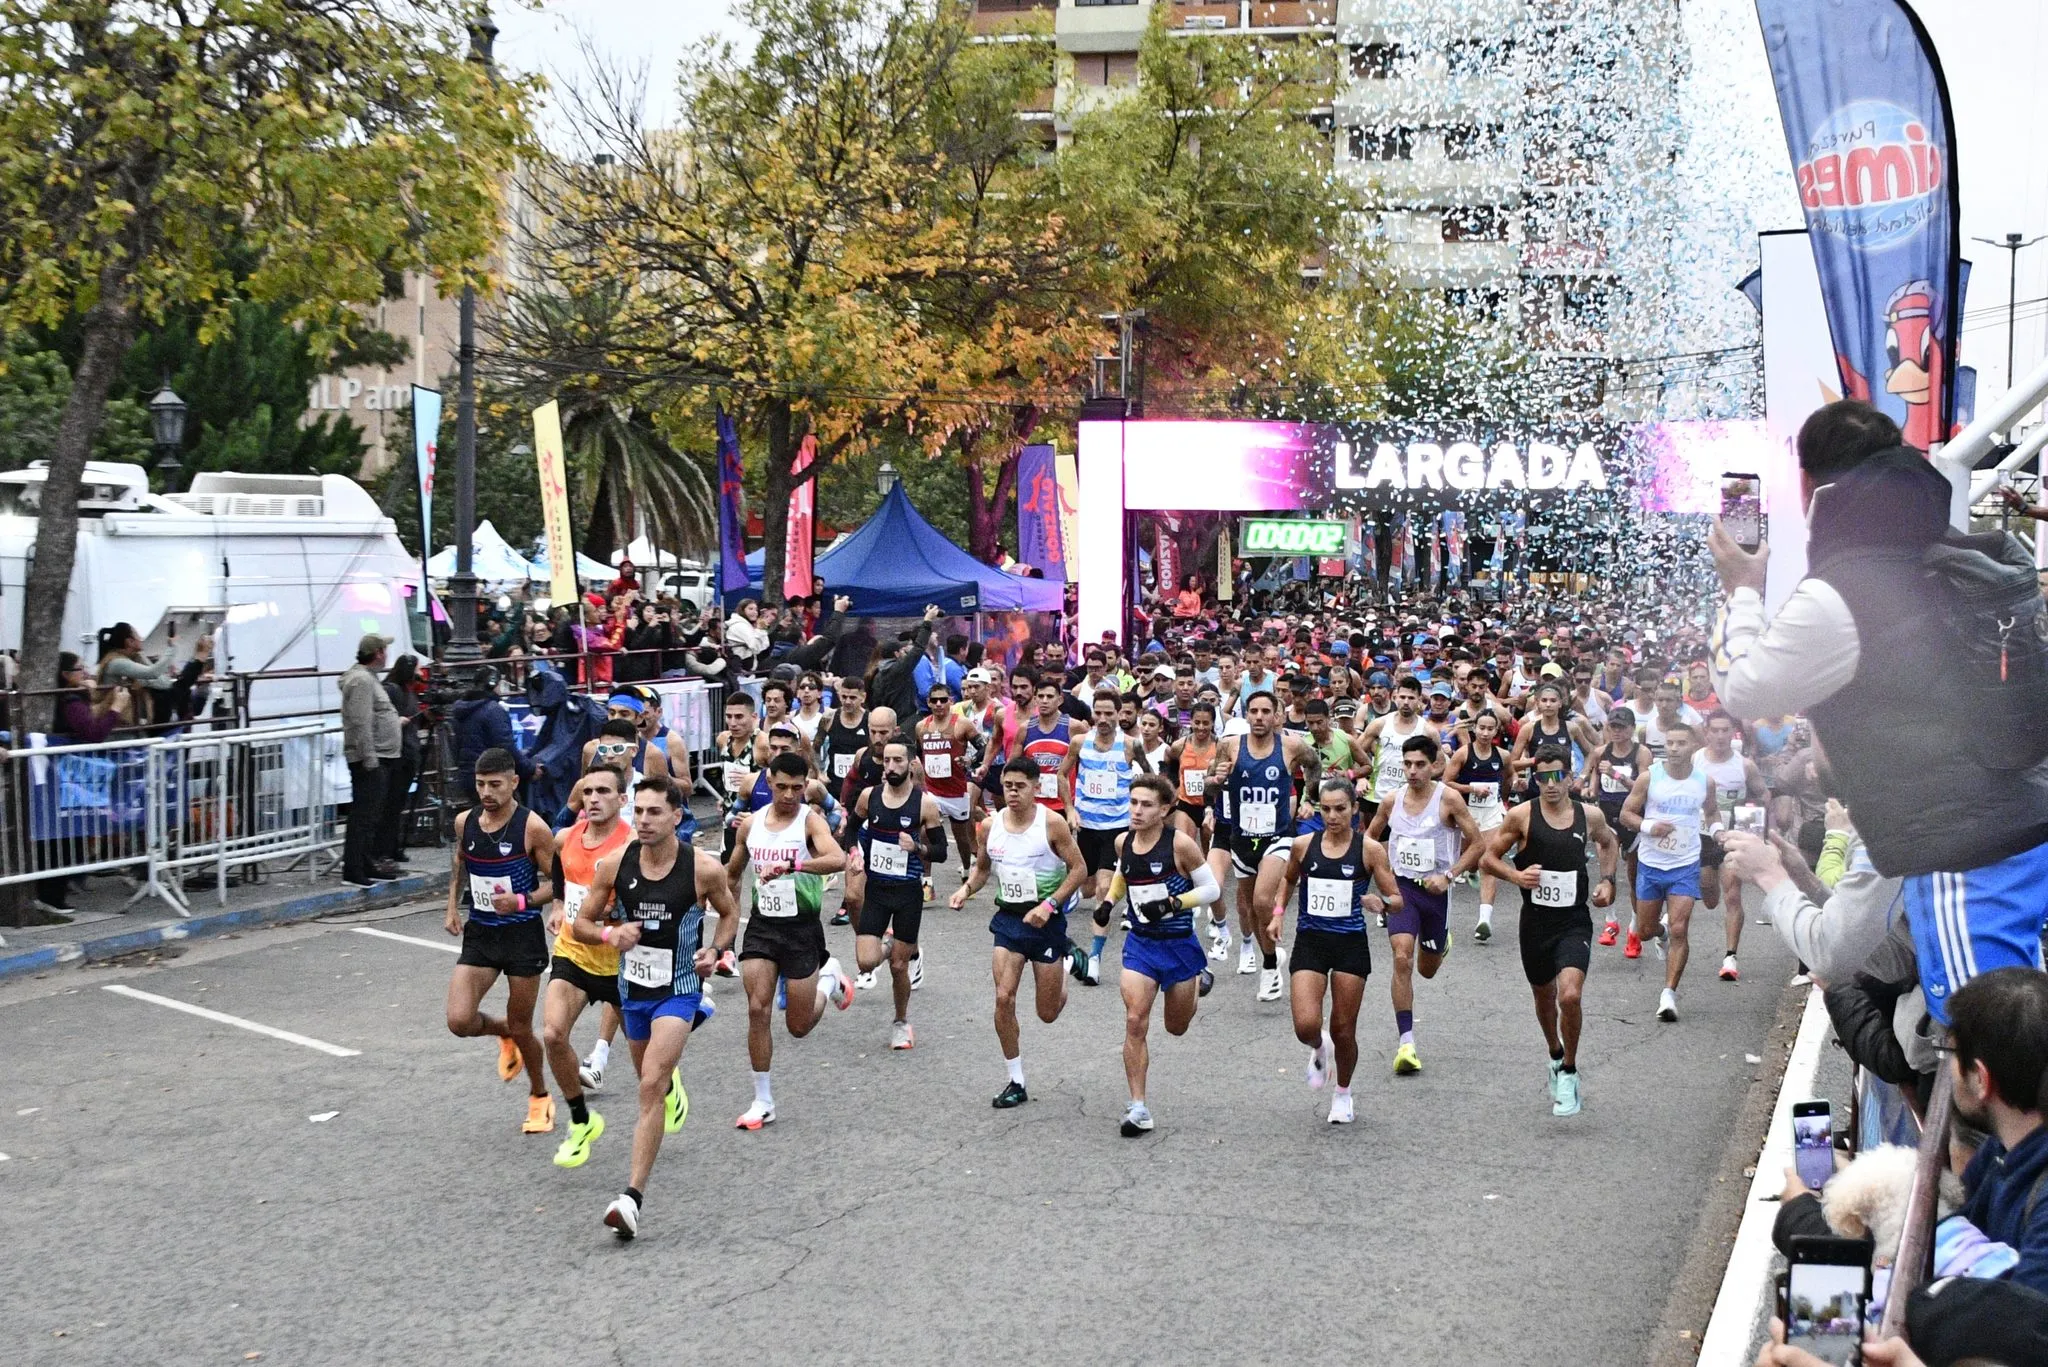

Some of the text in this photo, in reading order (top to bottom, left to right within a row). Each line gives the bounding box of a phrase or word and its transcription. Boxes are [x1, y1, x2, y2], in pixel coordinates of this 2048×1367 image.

[1335, 442, 1606, 490] LARGADA
[923, 740, 952, 750] KENYA
[1089, 782, 1102, 795] 86
[1186, 780, 1203, 793] 356
[1239, 785, 1280, 805] CDC
[1247, 816, 1258, 830] 71
[872, 854, 893, 870] 378
[1399, 851, 1421, 867] 355
[1002, 882, 1022, 898] 359
[1535, 884, 1560, 902] 393
[474, 890, 496, 907] 36
[639, 902, 666, 911] ROSARIO
[761, 895, 781, 911] 358
[1311, 894, 1335, 912] 376
[567, 900, 580, 920] 35
[630, 960, 652, 981] 351
